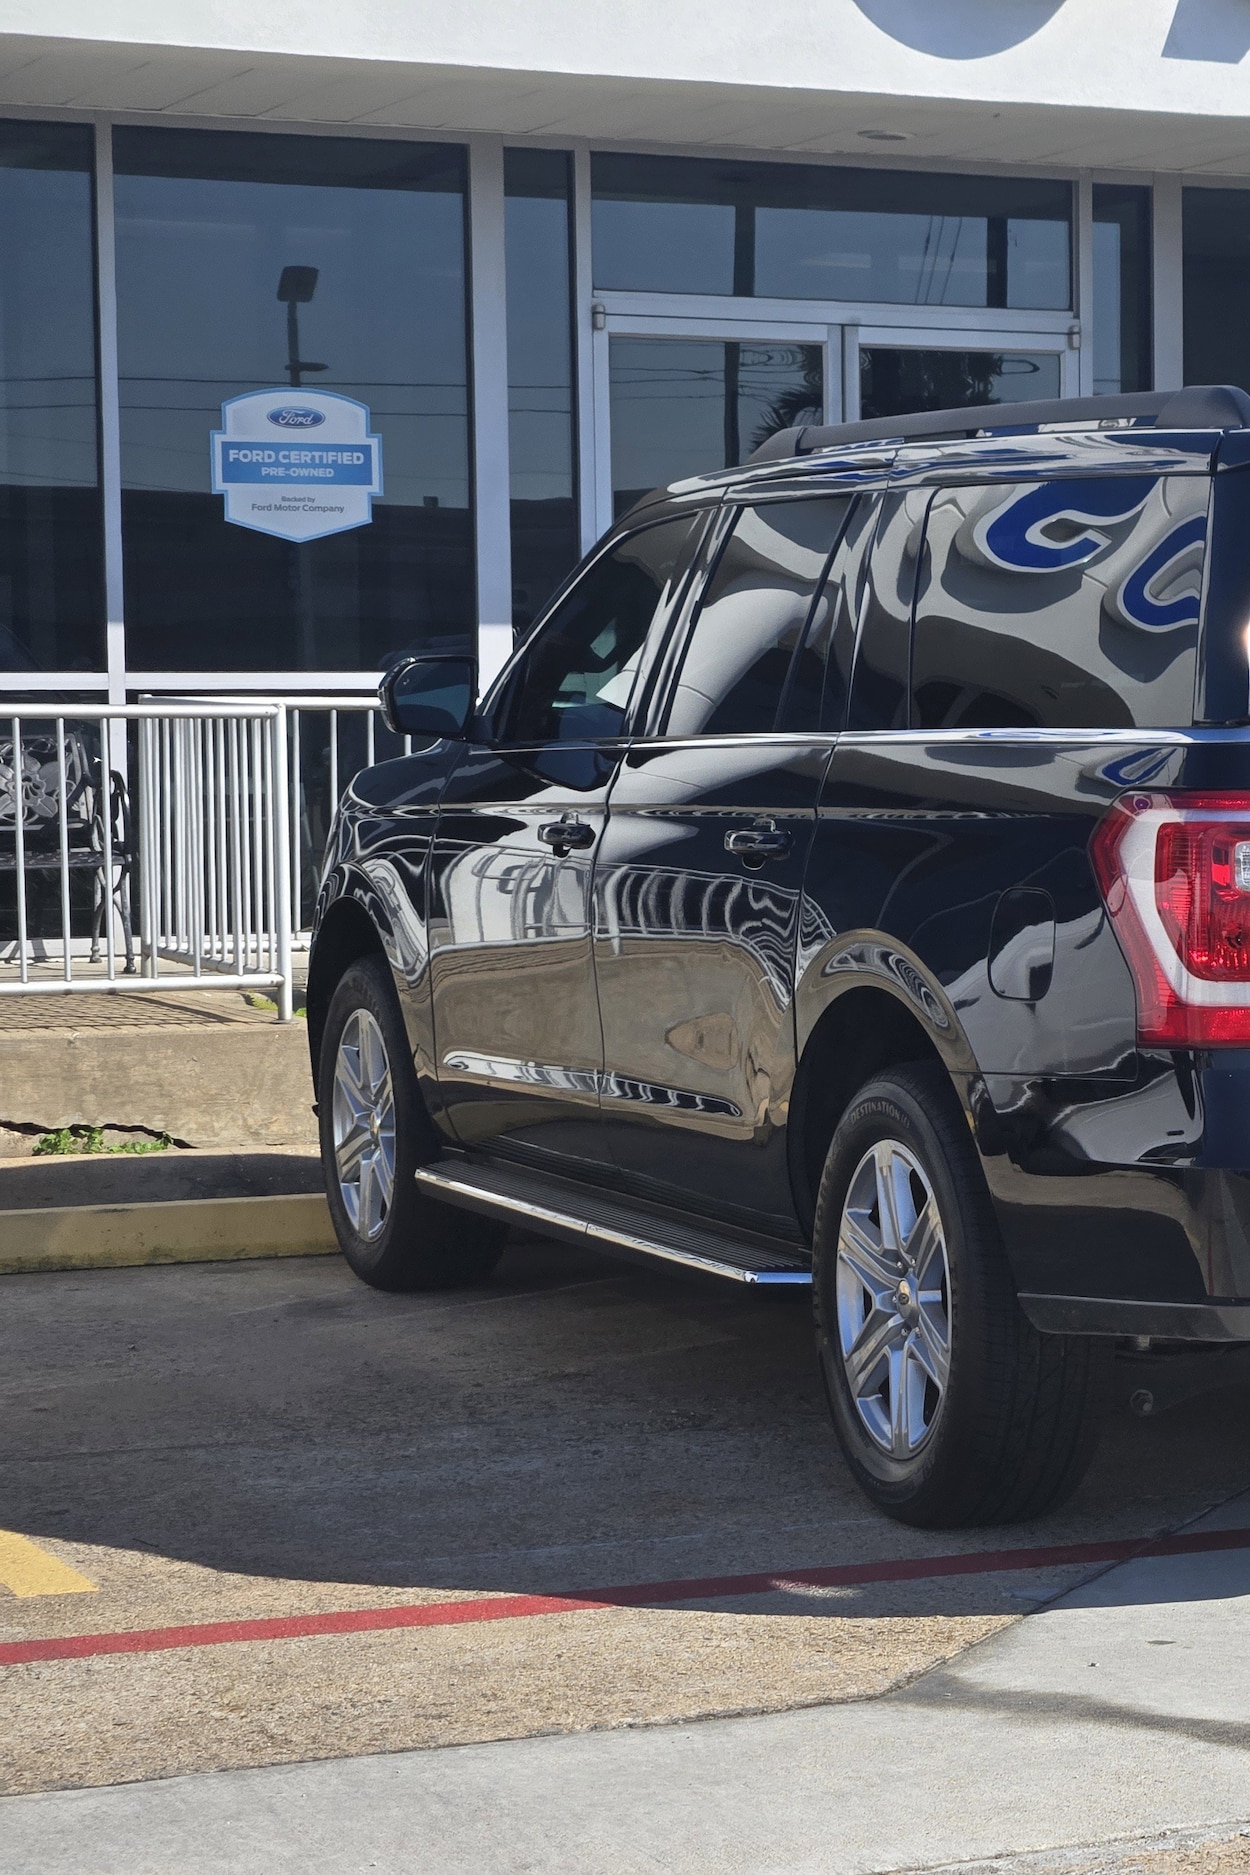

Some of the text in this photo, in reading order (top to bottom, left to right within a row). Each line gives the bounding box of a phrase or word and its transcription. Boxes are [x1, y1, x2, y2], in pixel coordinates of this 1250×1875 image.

[278, 410, 314, 425] Ford
[229, 450, 364, 465] FORD CERTIFIED
[261, 467, 334, 477] PRE-OWNED
[251, 503, 344, 514] Ford Motor Company
[850, 1101, 901, 1124] DESTINATION
